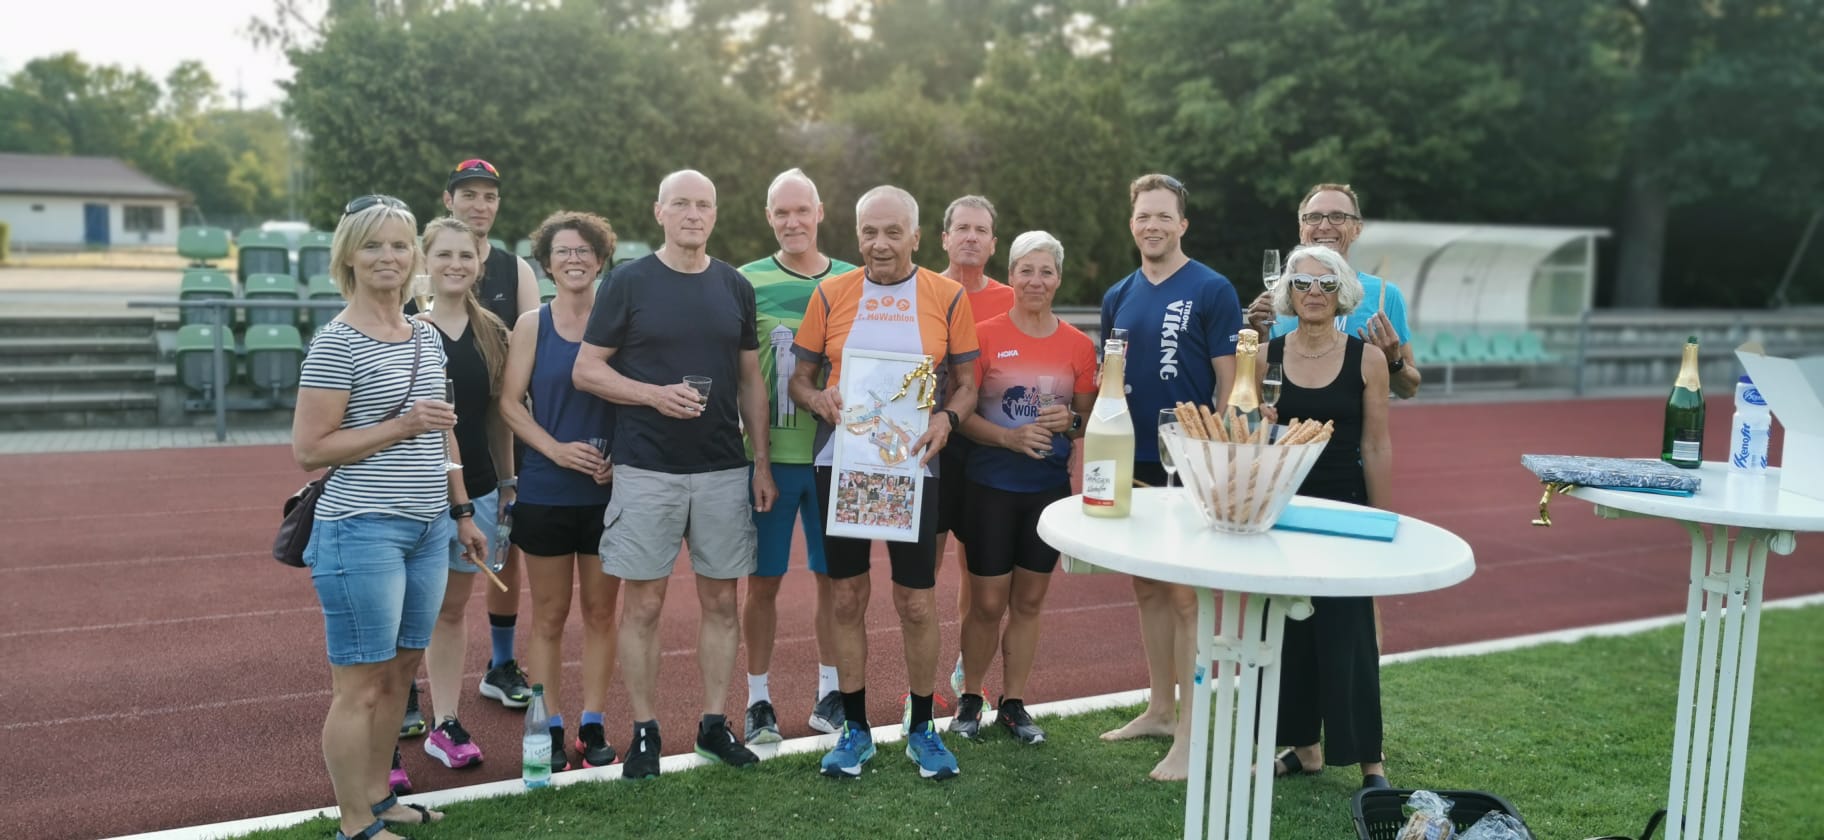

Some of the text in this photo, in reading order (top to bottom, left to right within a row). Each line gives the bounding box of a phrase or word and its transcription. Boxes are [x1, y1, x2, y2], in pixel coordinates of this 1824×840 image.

[1180, 300, 1193, 333] STRONG
[997, 349, 1019, 359] HOKA
[1160, 299, 1185, 380] VIKING
[1014, 403, 1042, 417] WOR
[1733, 422, 1751, 469] Xenofit
